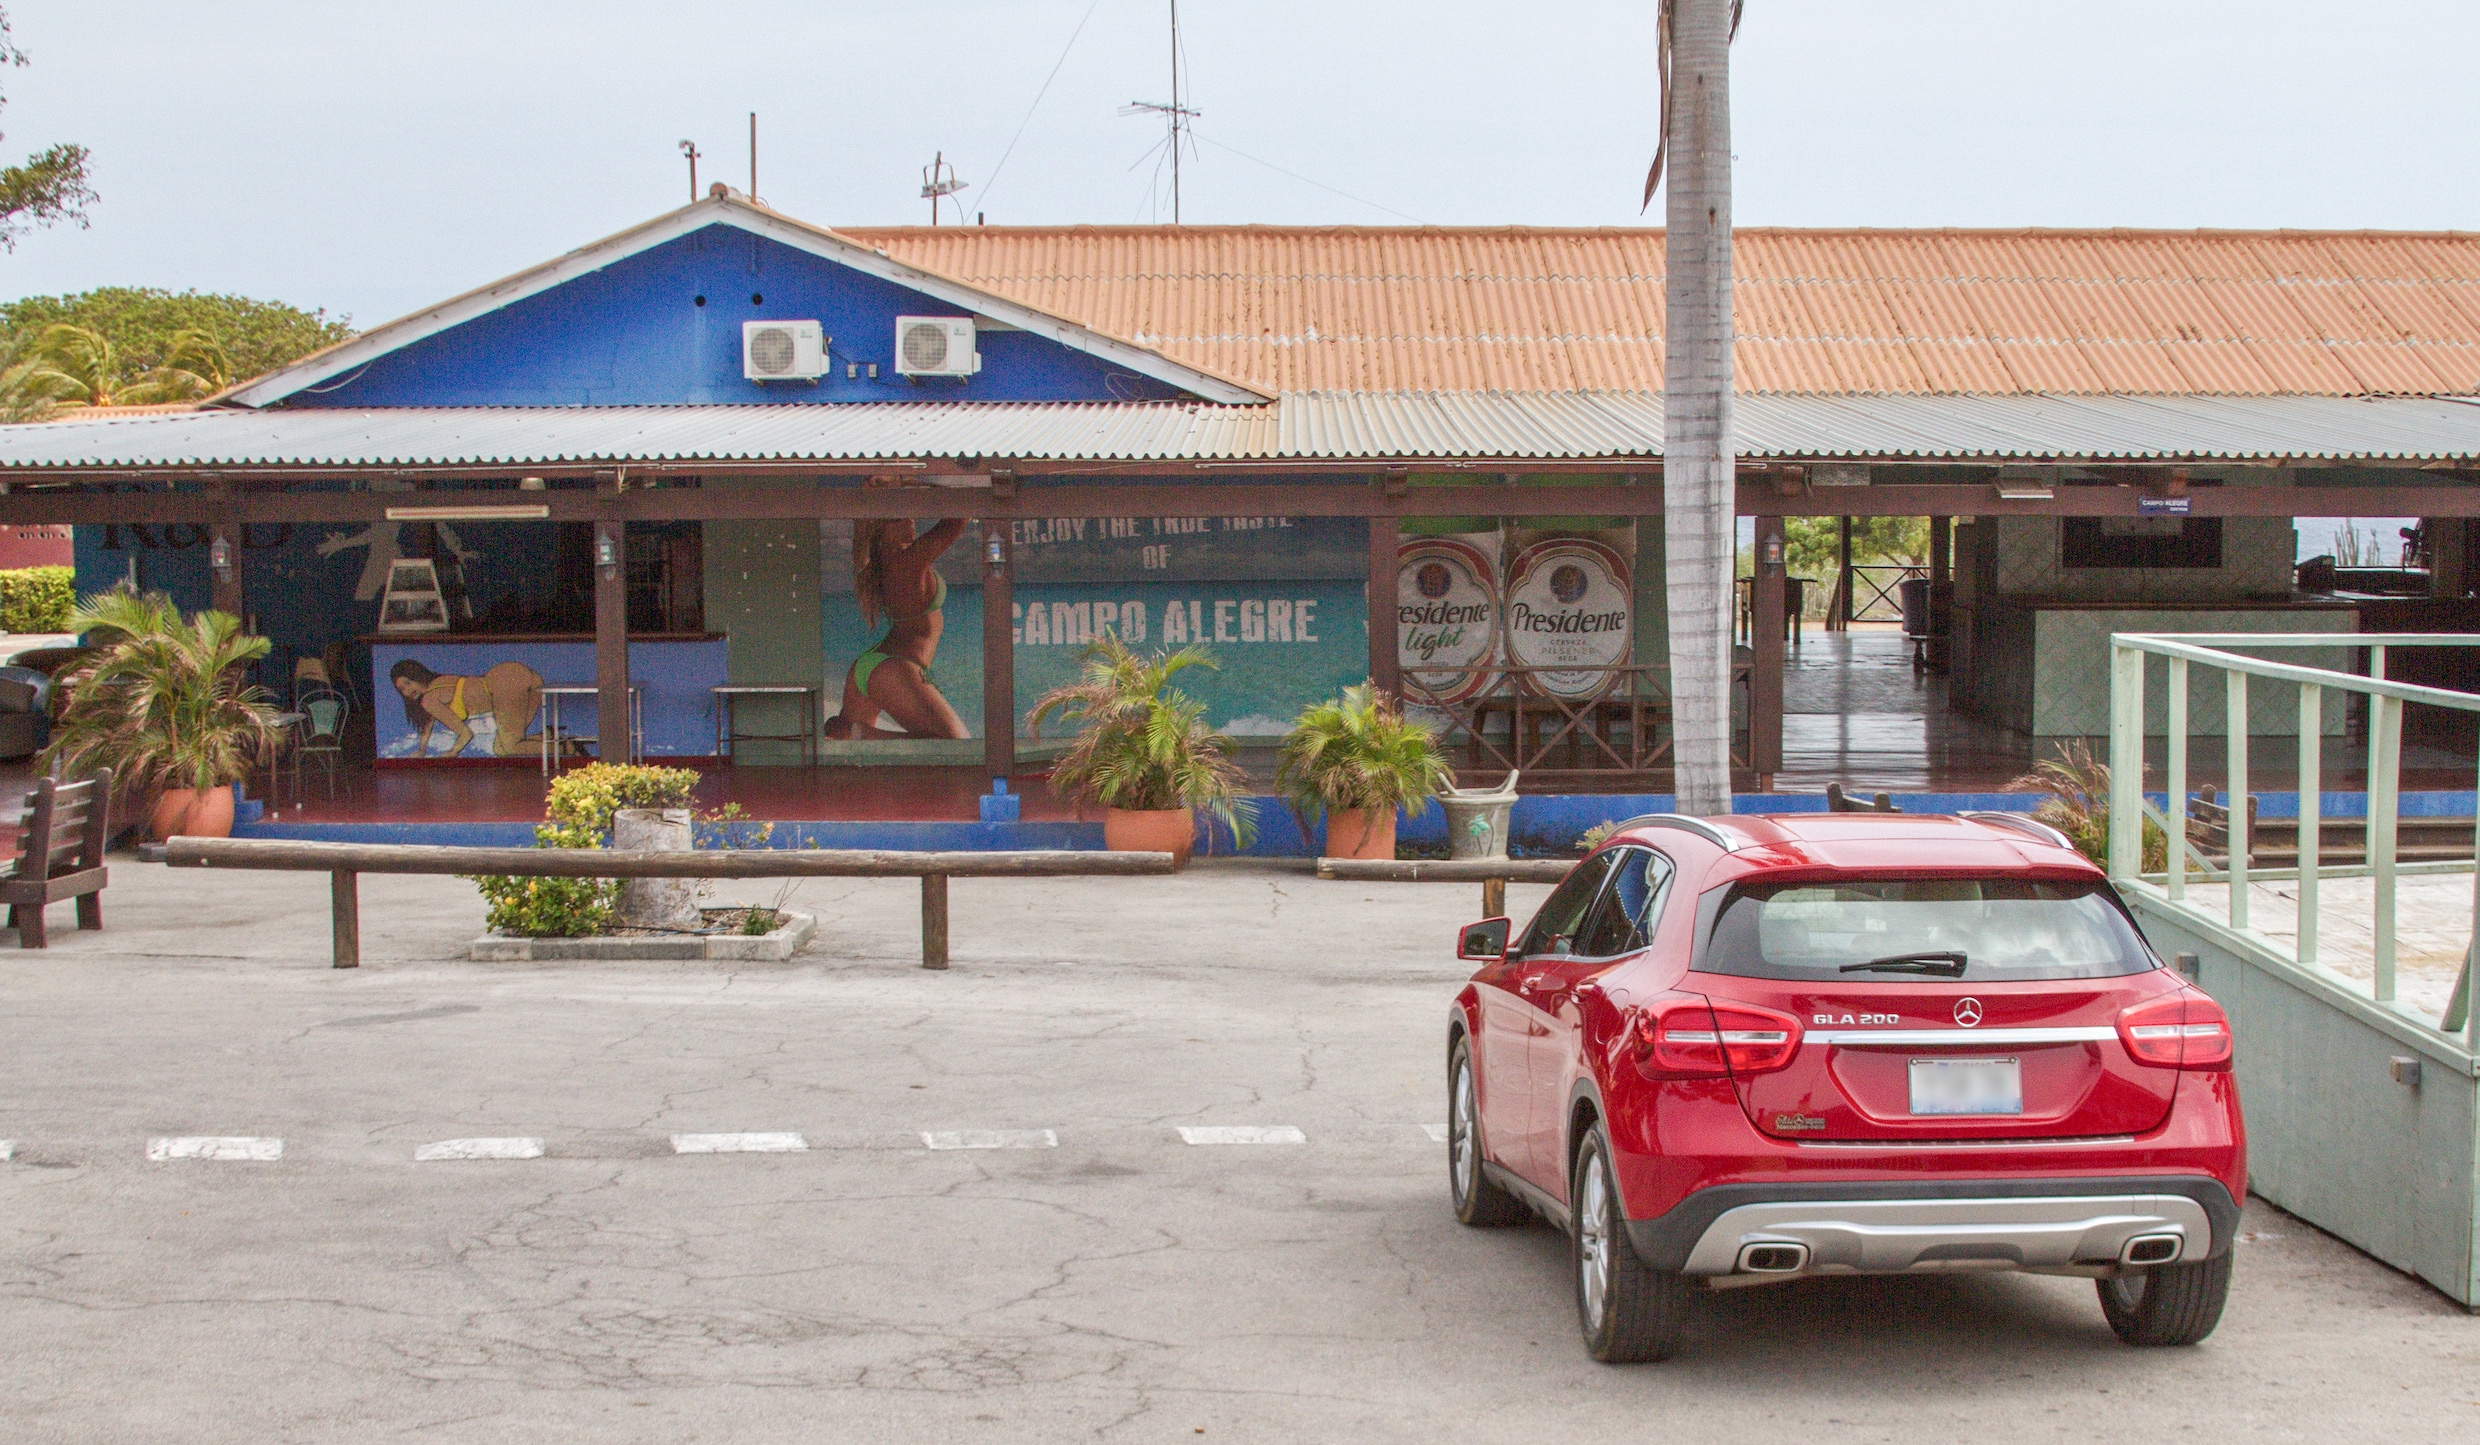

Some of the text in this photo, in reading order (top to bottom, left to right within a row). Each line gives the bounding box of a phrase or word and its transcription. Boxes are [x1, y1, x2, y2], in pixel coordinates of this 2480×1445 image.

[1011, 517, 1086, 545] ENJOY
[1142, 545, 1171, 569] OF
[1163, 600, 1318, 643] ALEGRE
[1511, 602, 1626, 633] Presidente
[1405, 626, 1466, 661] light
[1813, 1013, 1900, 1025] GLA 200
